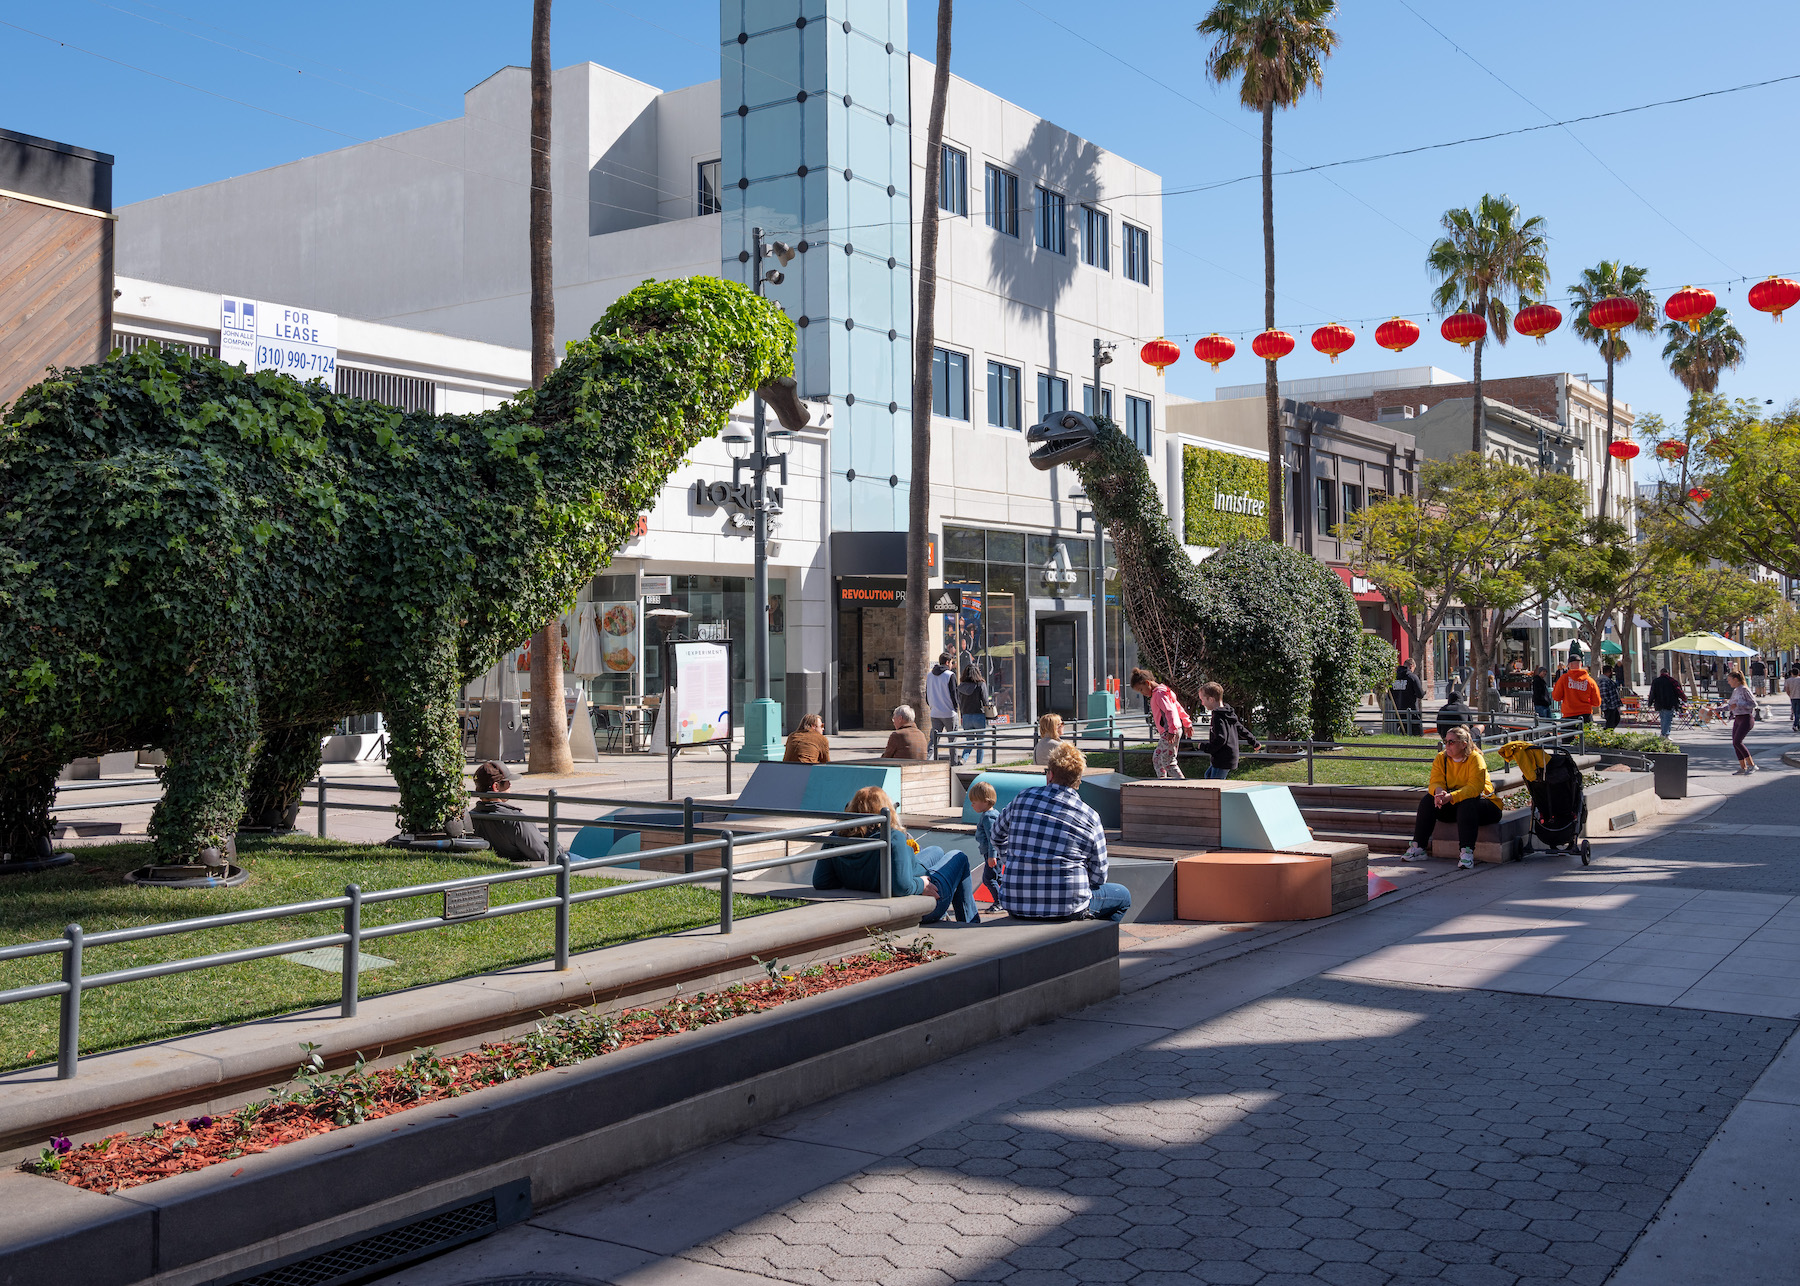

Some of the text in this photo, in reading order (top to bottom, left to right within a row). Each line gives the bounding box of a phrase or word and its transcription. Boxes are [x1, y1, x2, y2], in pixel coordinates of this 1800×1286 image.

[284, 310, 309, 325] FOR
[223, 330, 254, 340] JOHN ALLE
[276, 323, 319, 343] LEASE
[223, 337, 254, 347] COMPANY
[257, 345, 335, 373] (310) 990-7124
[1214, 486, 1265, 516] innisfree
[842, 588, 894, 600] REVOLUTION
[934, 604, 958, 612] adidas
